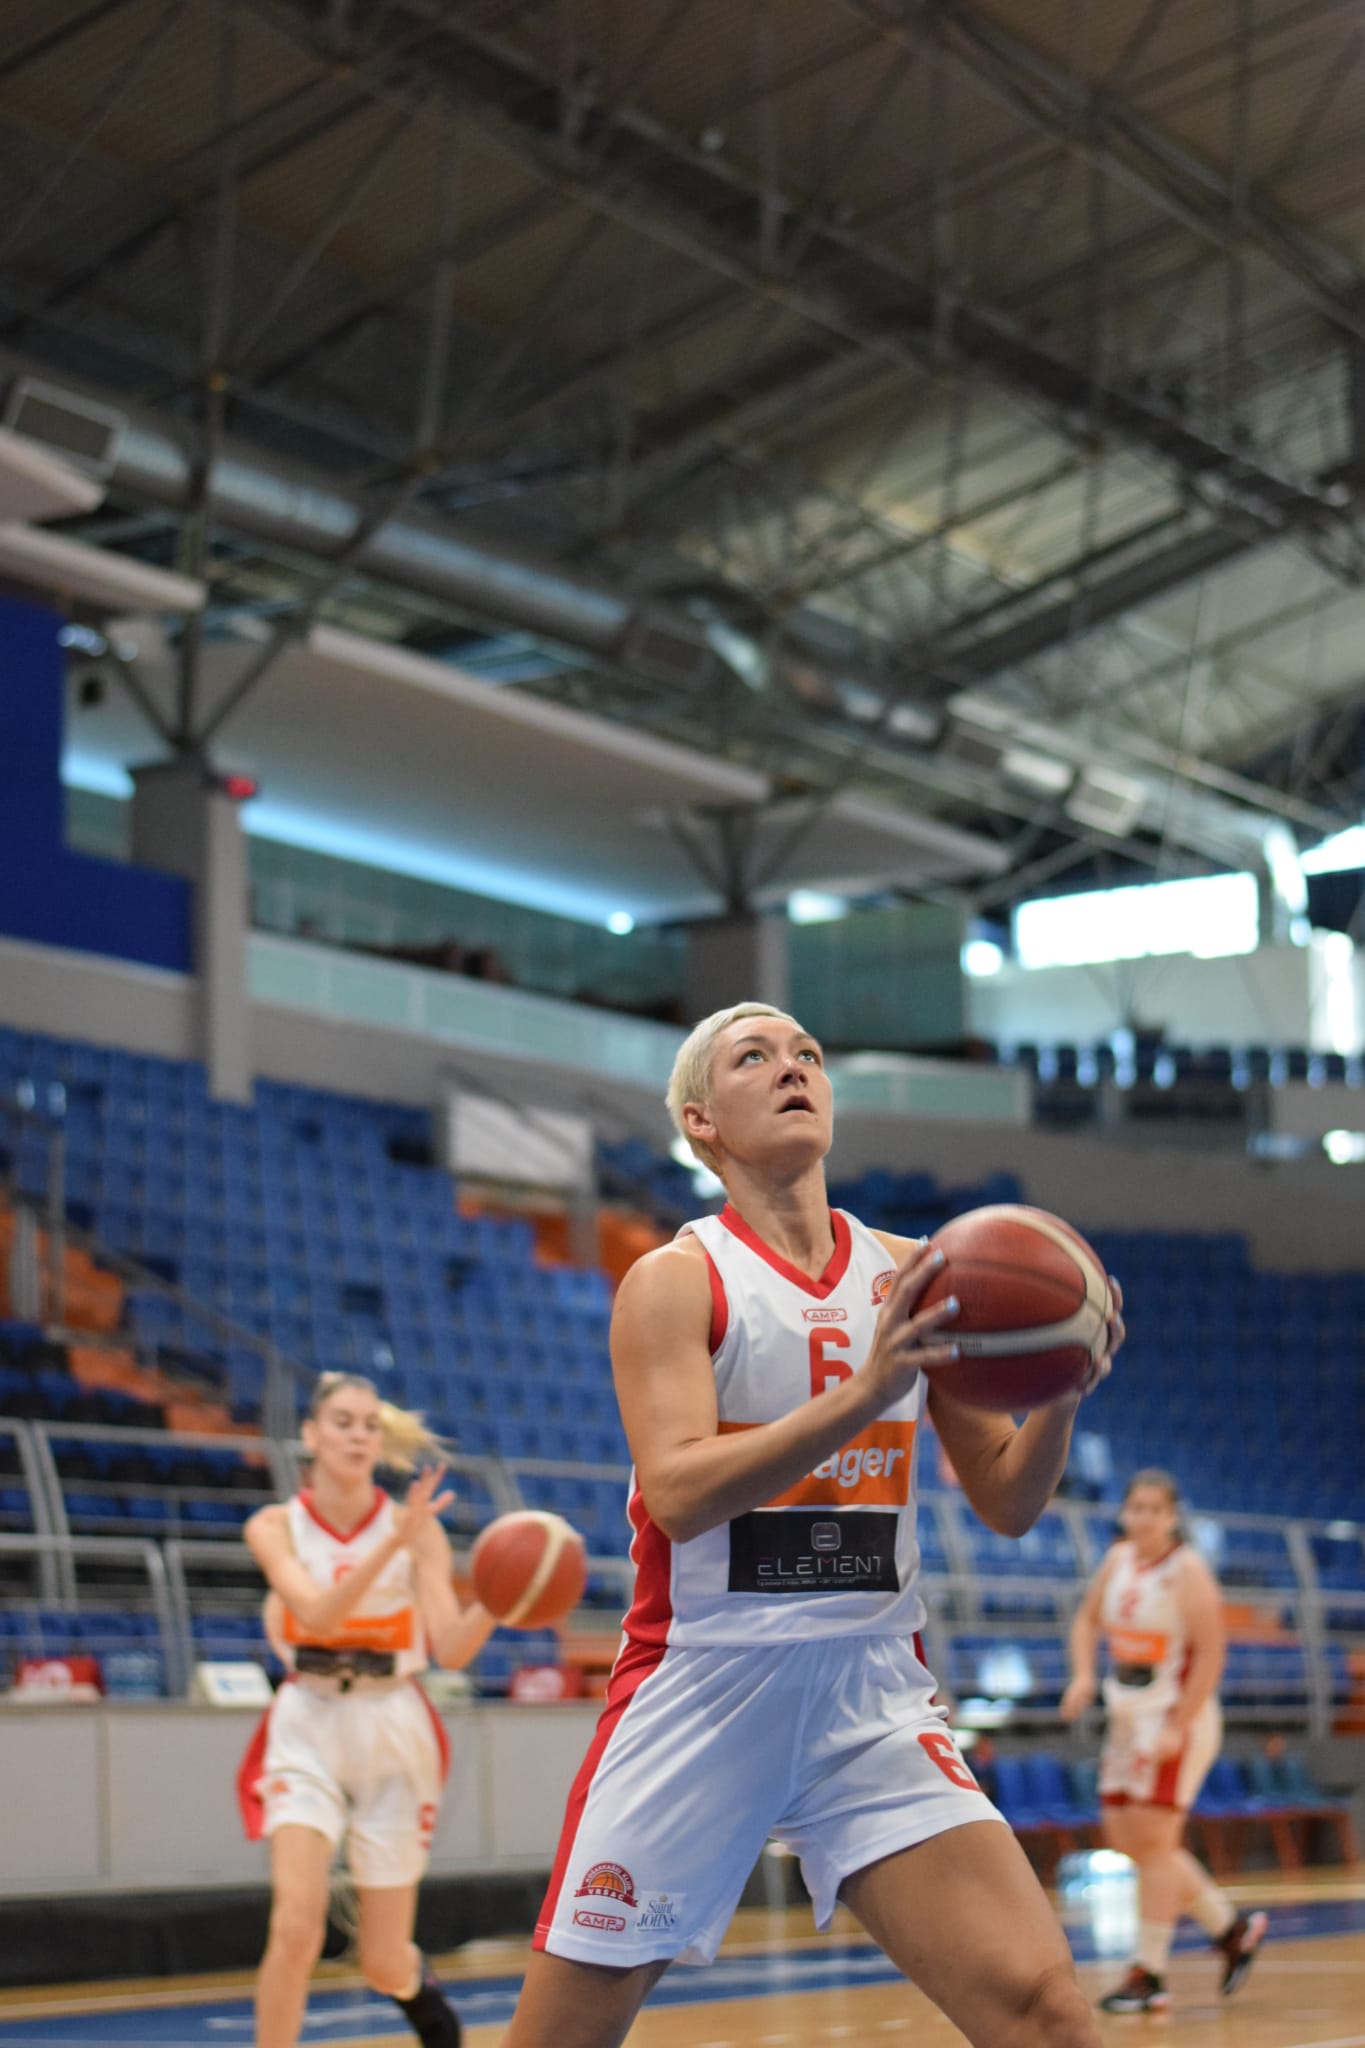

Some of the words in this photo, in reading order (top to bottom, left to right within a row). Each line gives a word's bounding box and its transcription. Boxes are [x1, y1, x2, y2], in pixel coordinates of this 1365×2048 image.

[809, 1327, 853, 1398] 6
[804, 1447, 904, 1488] ager
[757, 1555, 883, 1575] ELEMENT
[917, 1732, 982, 1792] 6
[647, 1900, 674, 1914] Saint
